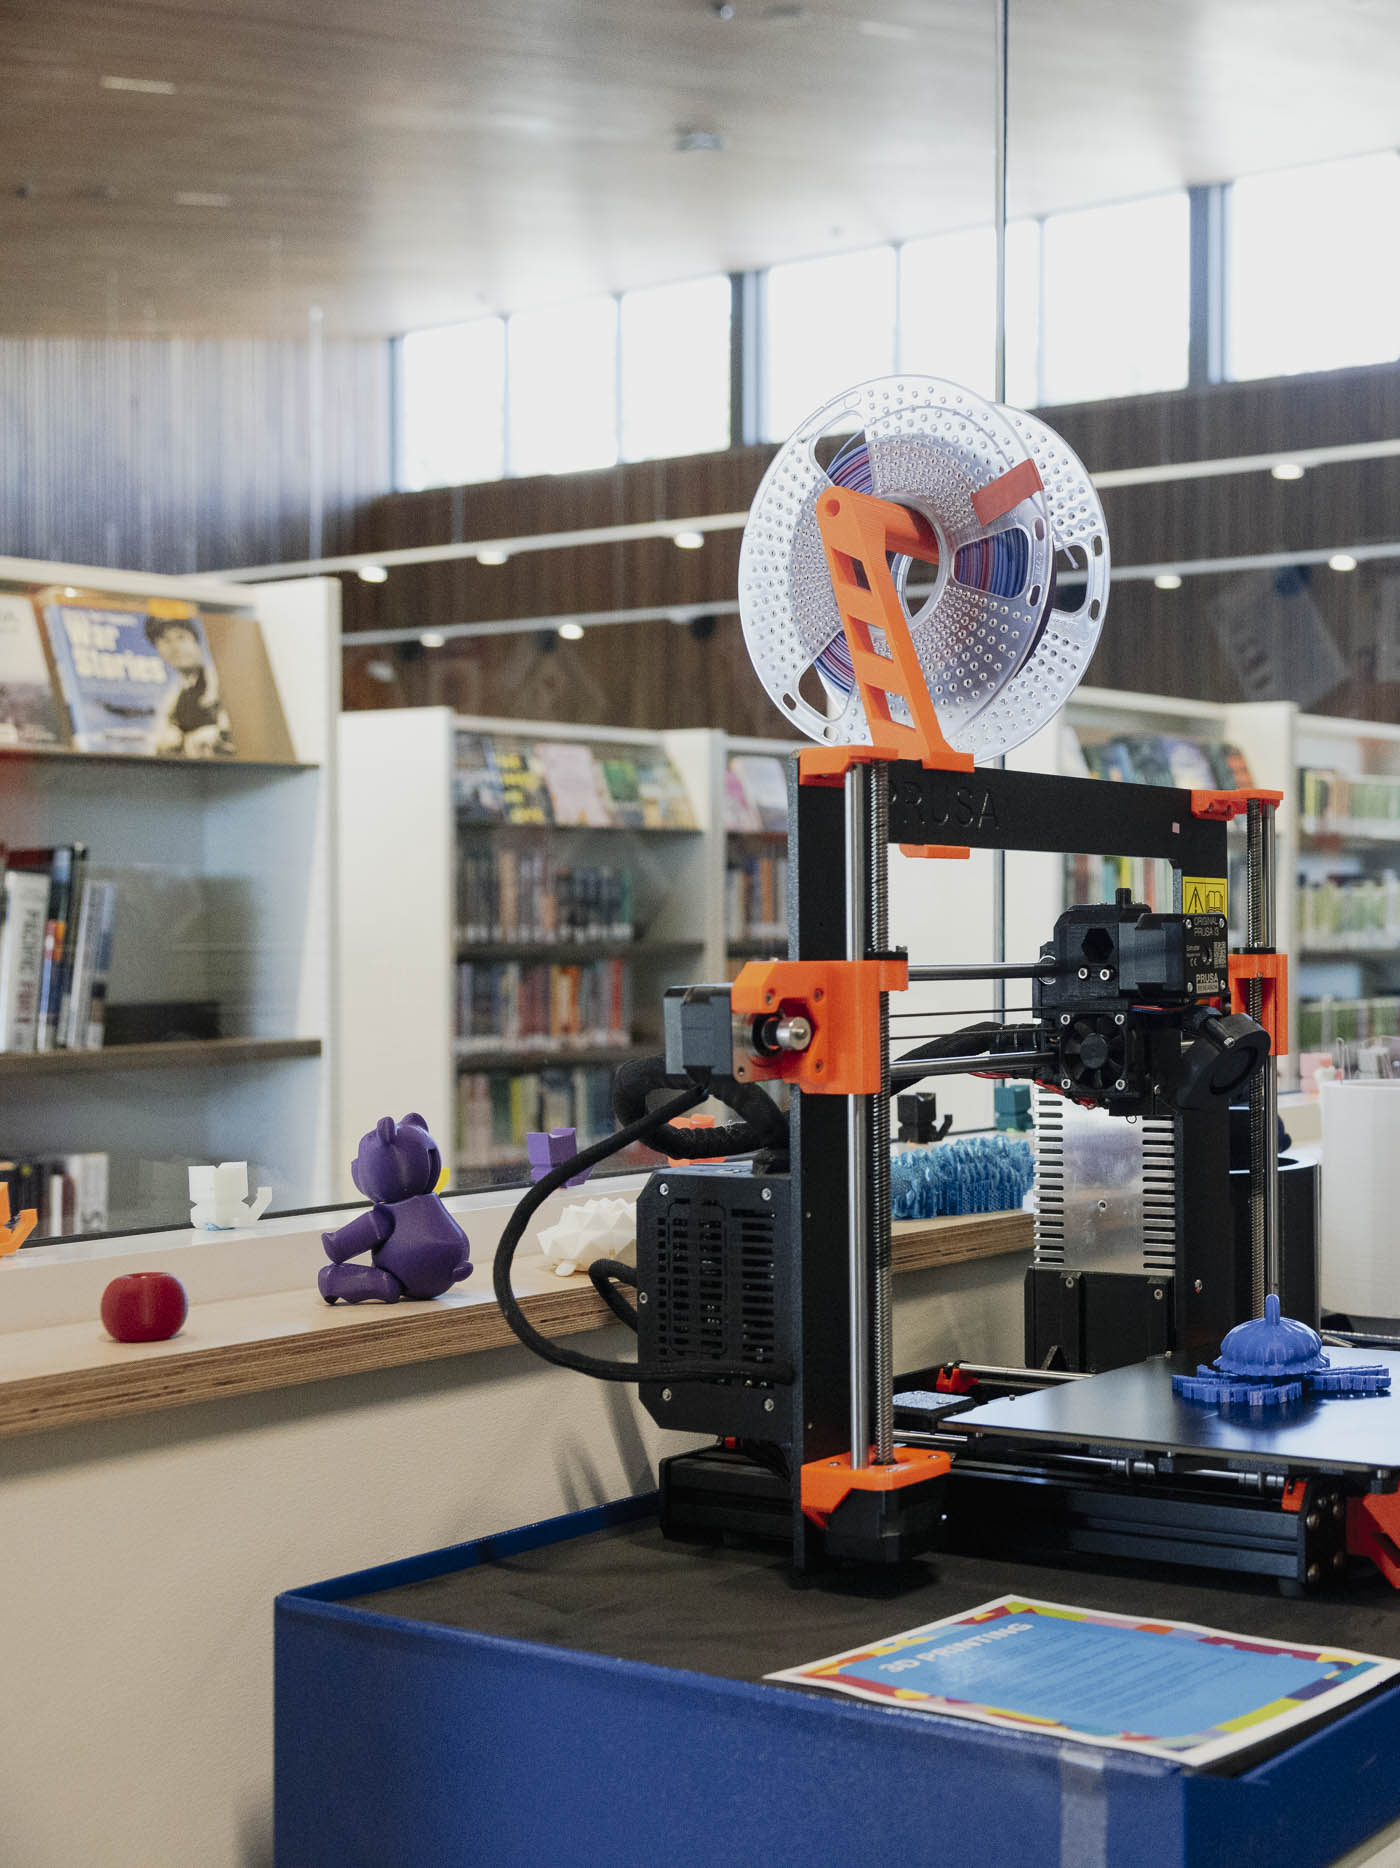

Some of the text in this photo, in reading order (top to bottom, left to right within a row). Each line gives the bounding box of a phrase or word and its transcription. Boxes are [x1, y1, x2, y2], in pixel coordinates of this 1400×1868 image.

[1194, 917, 1218, 926] ORIGINAL
[1194, 927, 1213, 936] PRUSA
[1196, 973, 1218, 984] PRUSA
[878, 1623, 1034, 1673] 3D PRINTING
